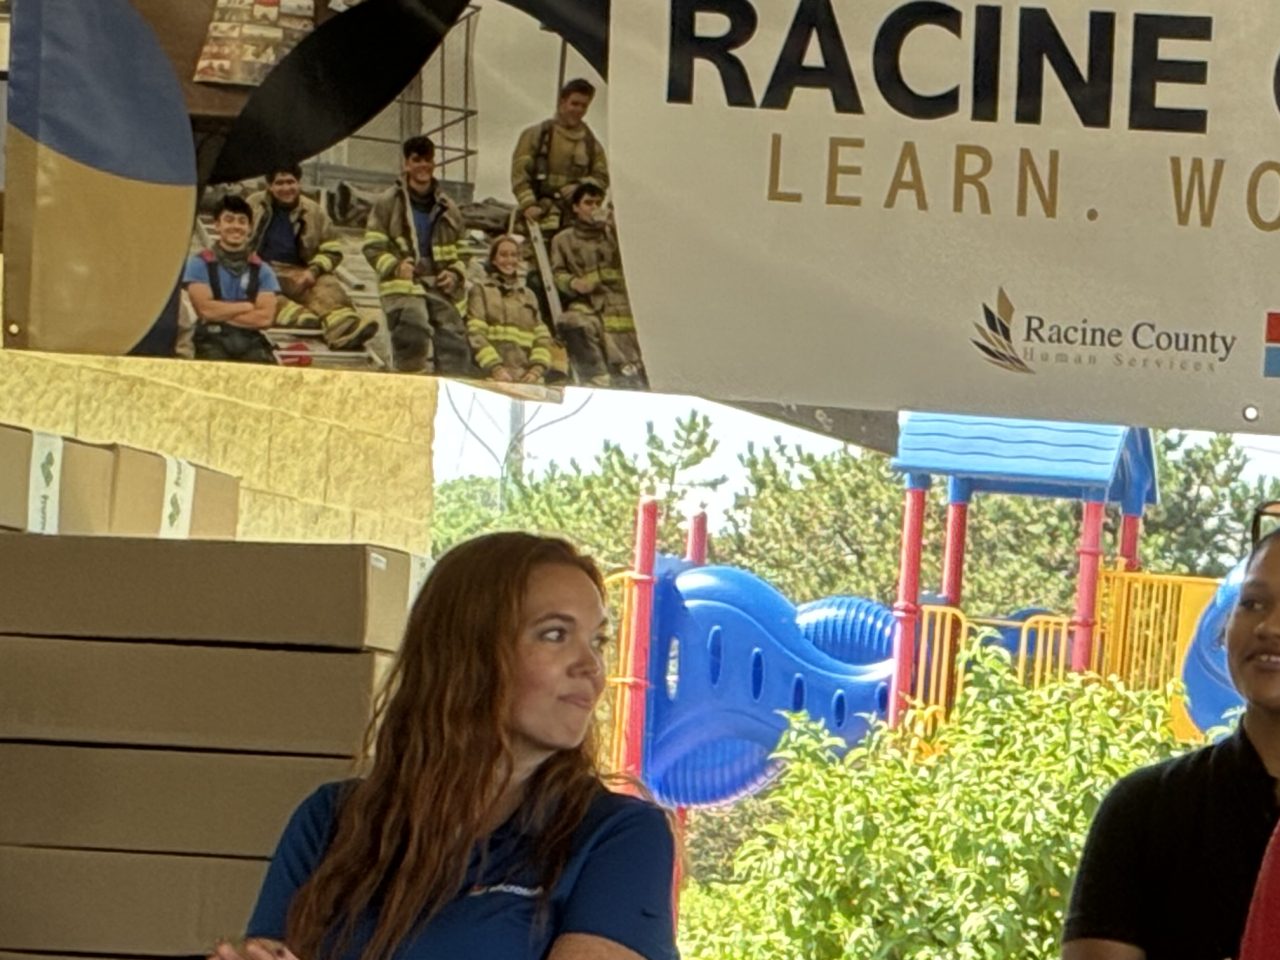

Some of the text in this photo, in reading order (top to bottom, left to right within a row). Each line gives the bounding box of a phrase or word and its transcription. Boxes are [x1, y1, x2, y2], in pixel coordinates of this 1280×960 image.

[666, 0, 1213, 134] RACINE
[767, 133, 1099, 222] LEARN.
[1022, 347, 1217, 372] Human Services
[1024, 315, 1237, 362] Racine County
